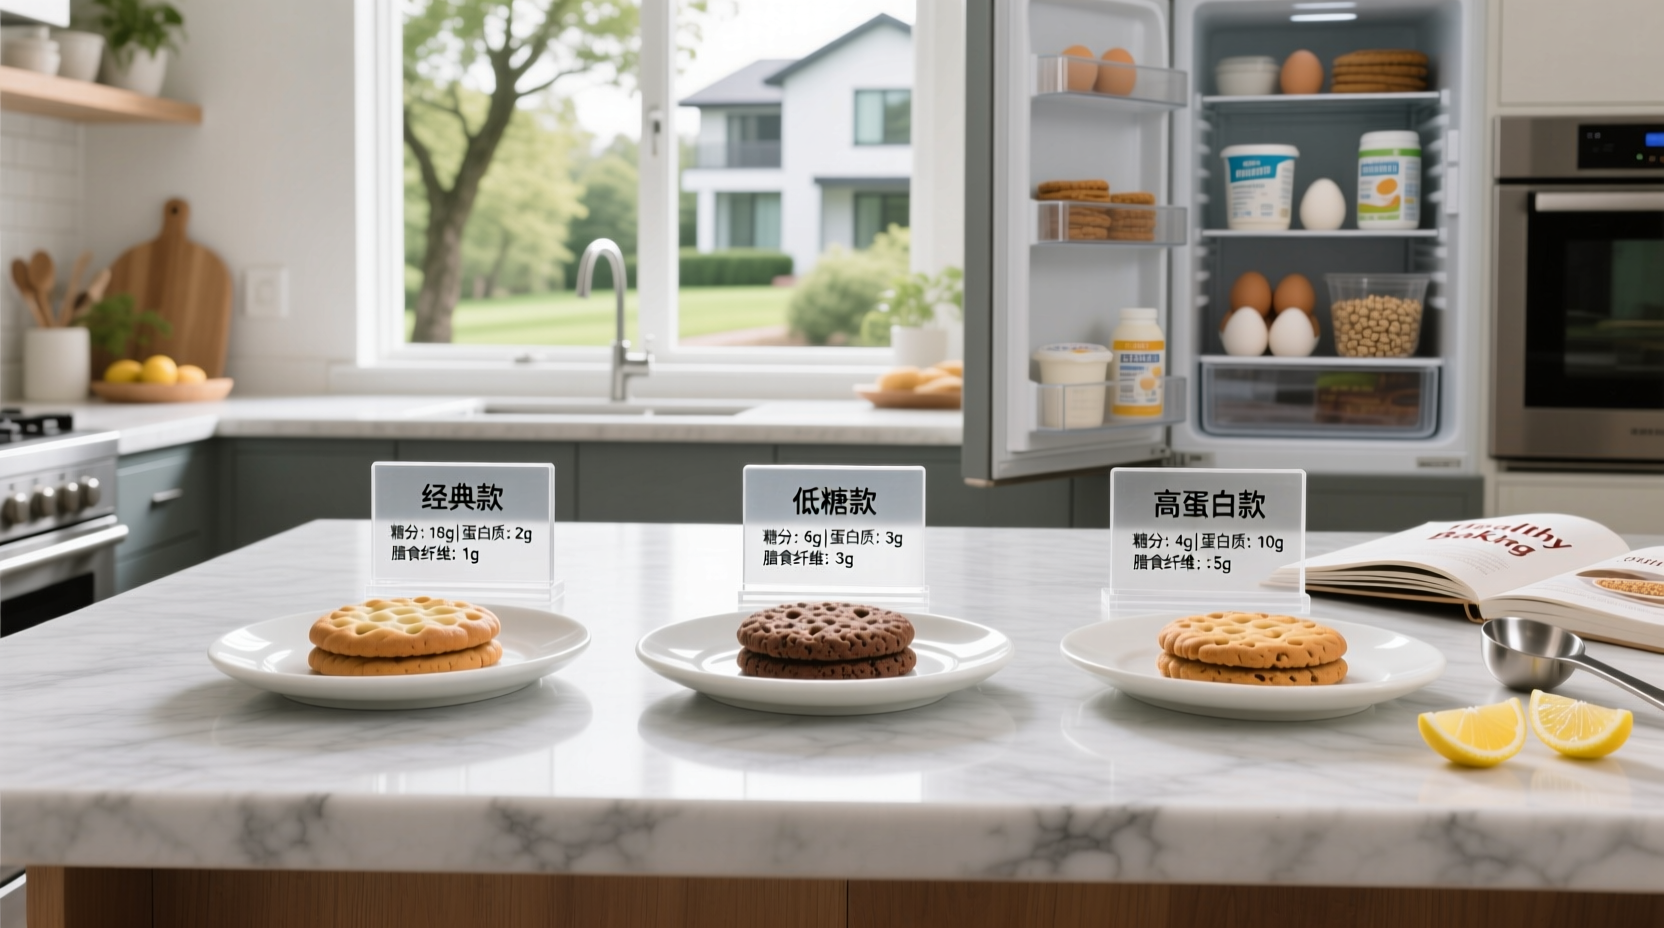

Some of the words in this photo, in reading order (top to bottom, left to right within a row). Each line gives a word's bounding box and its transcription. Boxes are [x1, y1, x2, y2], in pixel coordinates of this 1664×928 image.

[421, 482, 504, 512] 经典款
[792, 486, 877, 516] 低糖款
[1153, 488, 1266, 519] 高蛋白款
